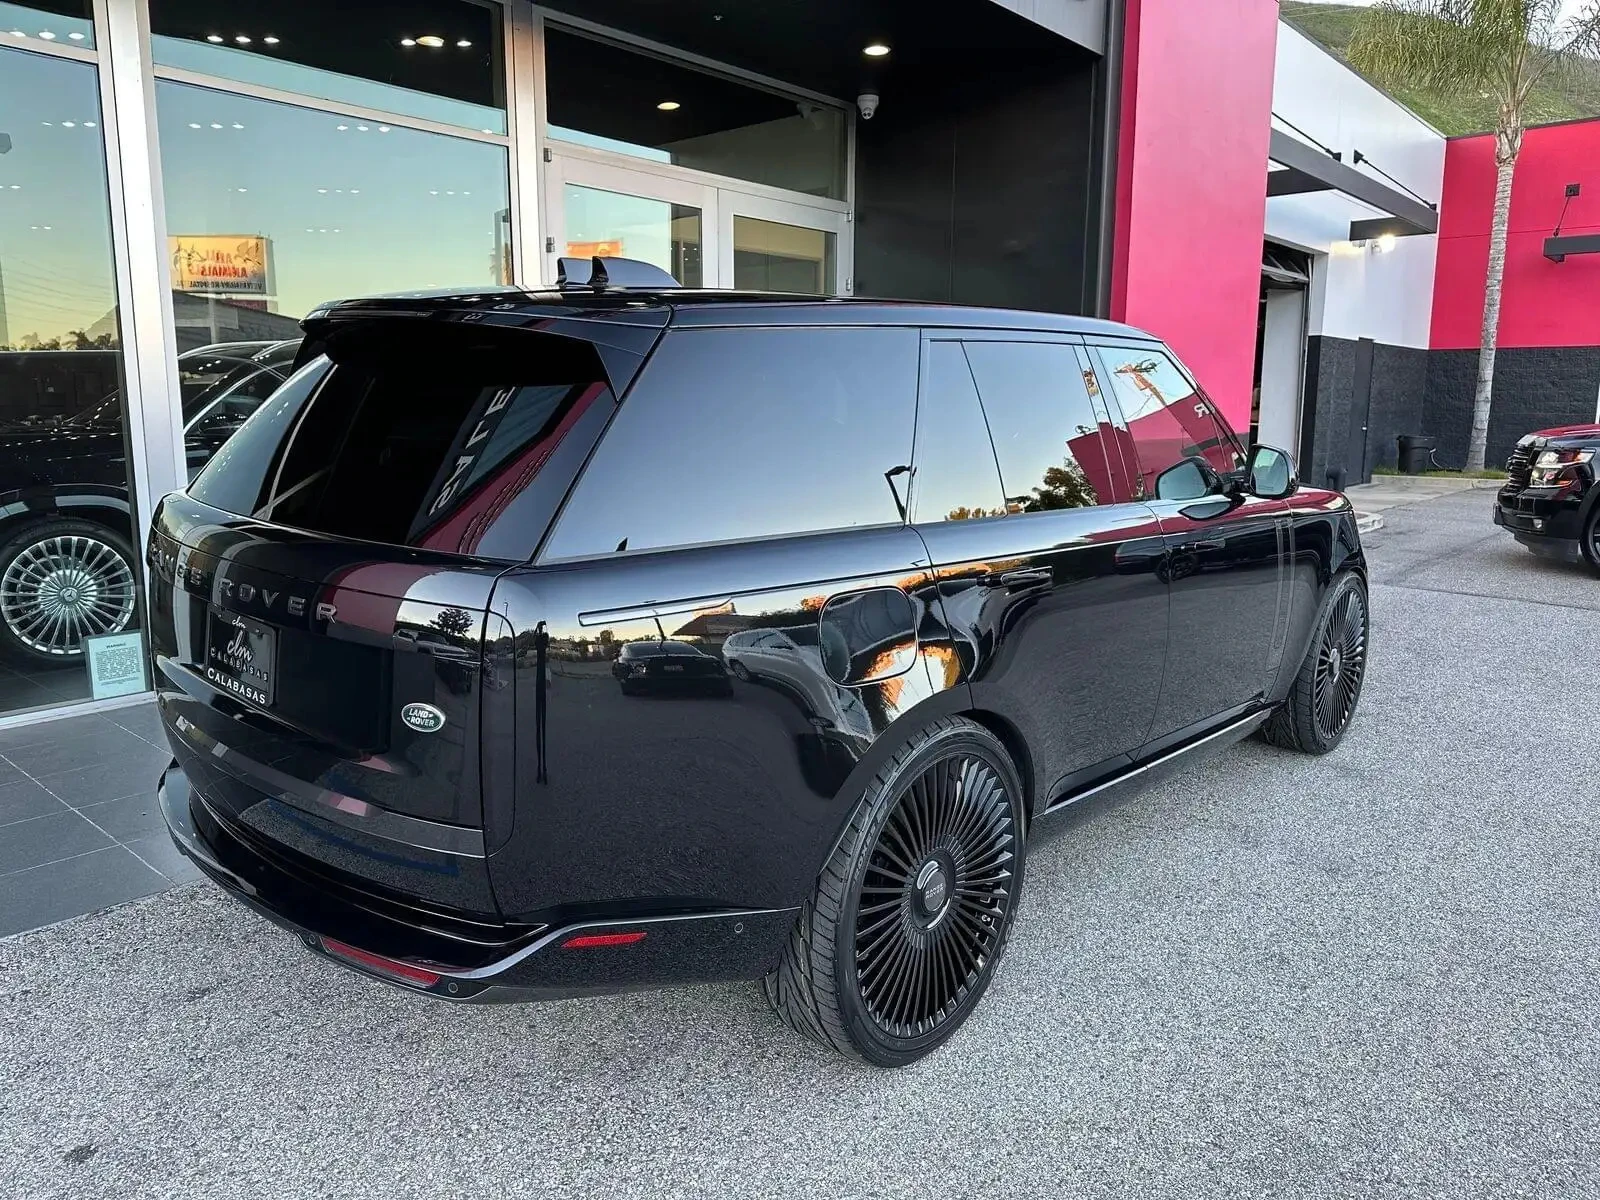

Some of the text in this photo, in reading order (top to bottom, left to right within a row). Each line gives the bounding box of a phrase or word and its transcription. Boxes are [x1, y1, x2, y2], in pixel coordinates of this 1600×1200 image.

[152, 543, 337, 624] ANGE ROVER
[210, 646, 269, 681] CALABASAS
[207, 667, 266, 704] CALABASAS
[409, 708, 429, 718] LAND
[410, 716, 435, 727] ROVER
[925, 882, 944, 895] RANGE
[925, 886, 944, 900] ROVER
